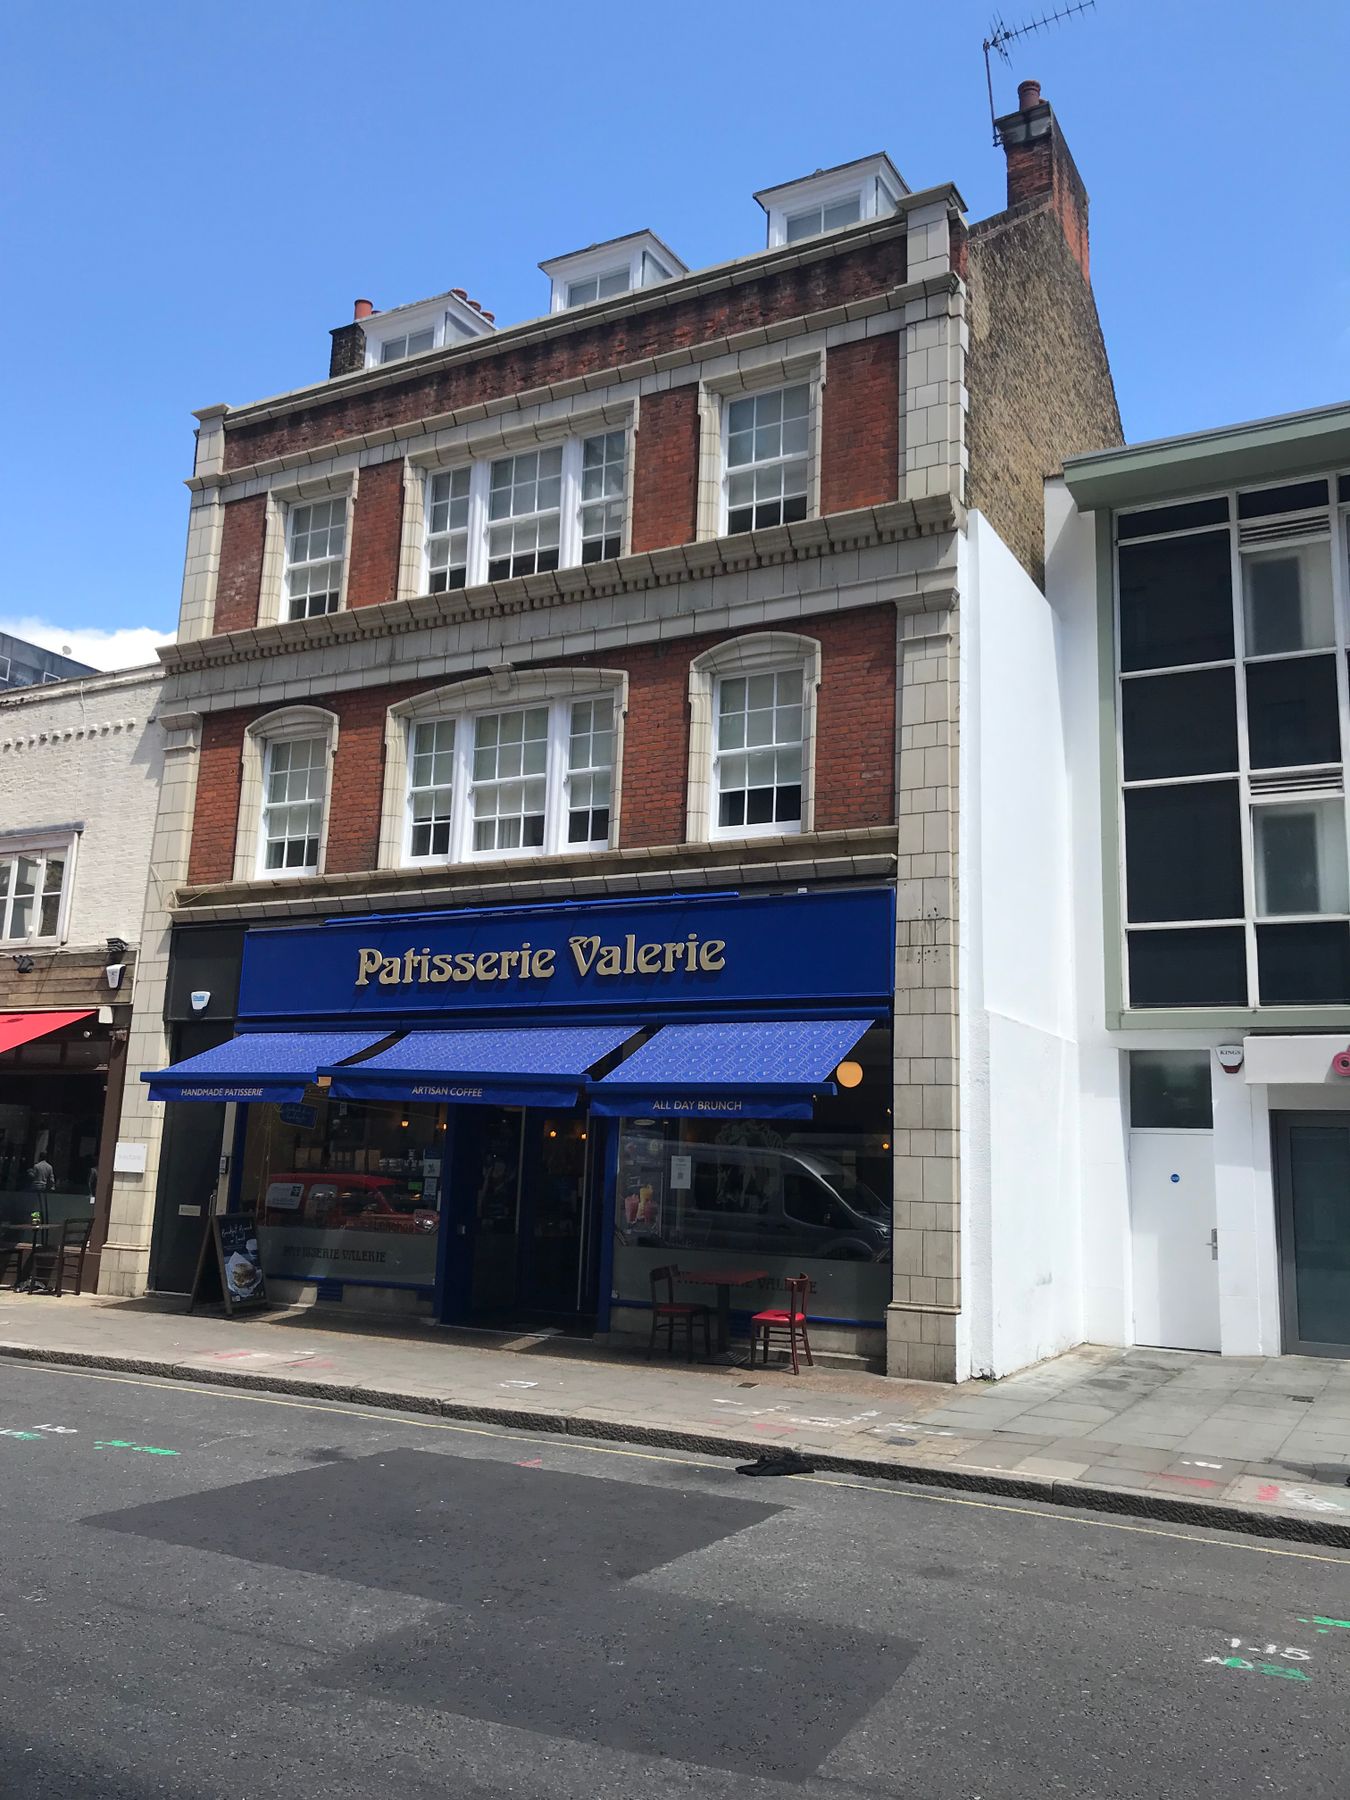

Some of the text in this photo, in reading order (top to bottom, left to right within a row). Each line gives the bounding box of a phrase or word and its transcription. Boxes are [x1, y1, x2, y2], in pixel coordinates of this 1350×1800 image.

[355, 933, 726, 986] Patisserie Valerie
[181, 1088, 264, 1097] HANDMADE PATISSERIE
[412, 1086, 483, 1097] ARTISAN COFFEE
[652, 1100, 742, 1111] ALL DAY BRUNCH
[342, 1249, 387, 1263] VALERIE
